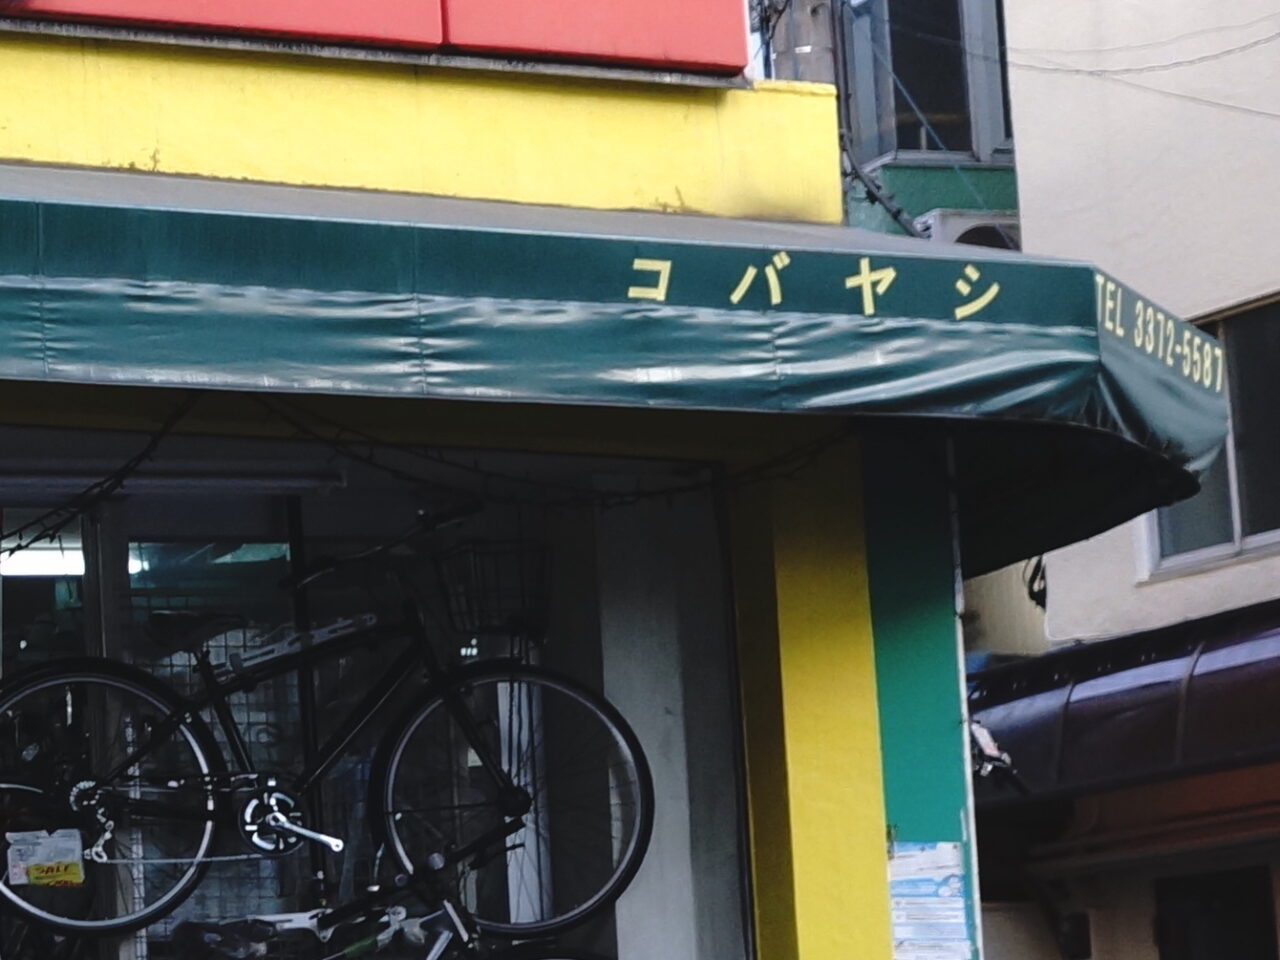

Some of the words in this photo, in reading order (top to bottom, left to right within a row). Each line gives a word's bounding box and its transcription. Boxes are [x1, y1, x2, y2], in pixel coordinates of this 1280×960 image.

[627, 250, 1000, 320] コバヤシ
[1095, 274, 1125, 338] TEL
[1133, 303, 1223, 393] 3372-5587
